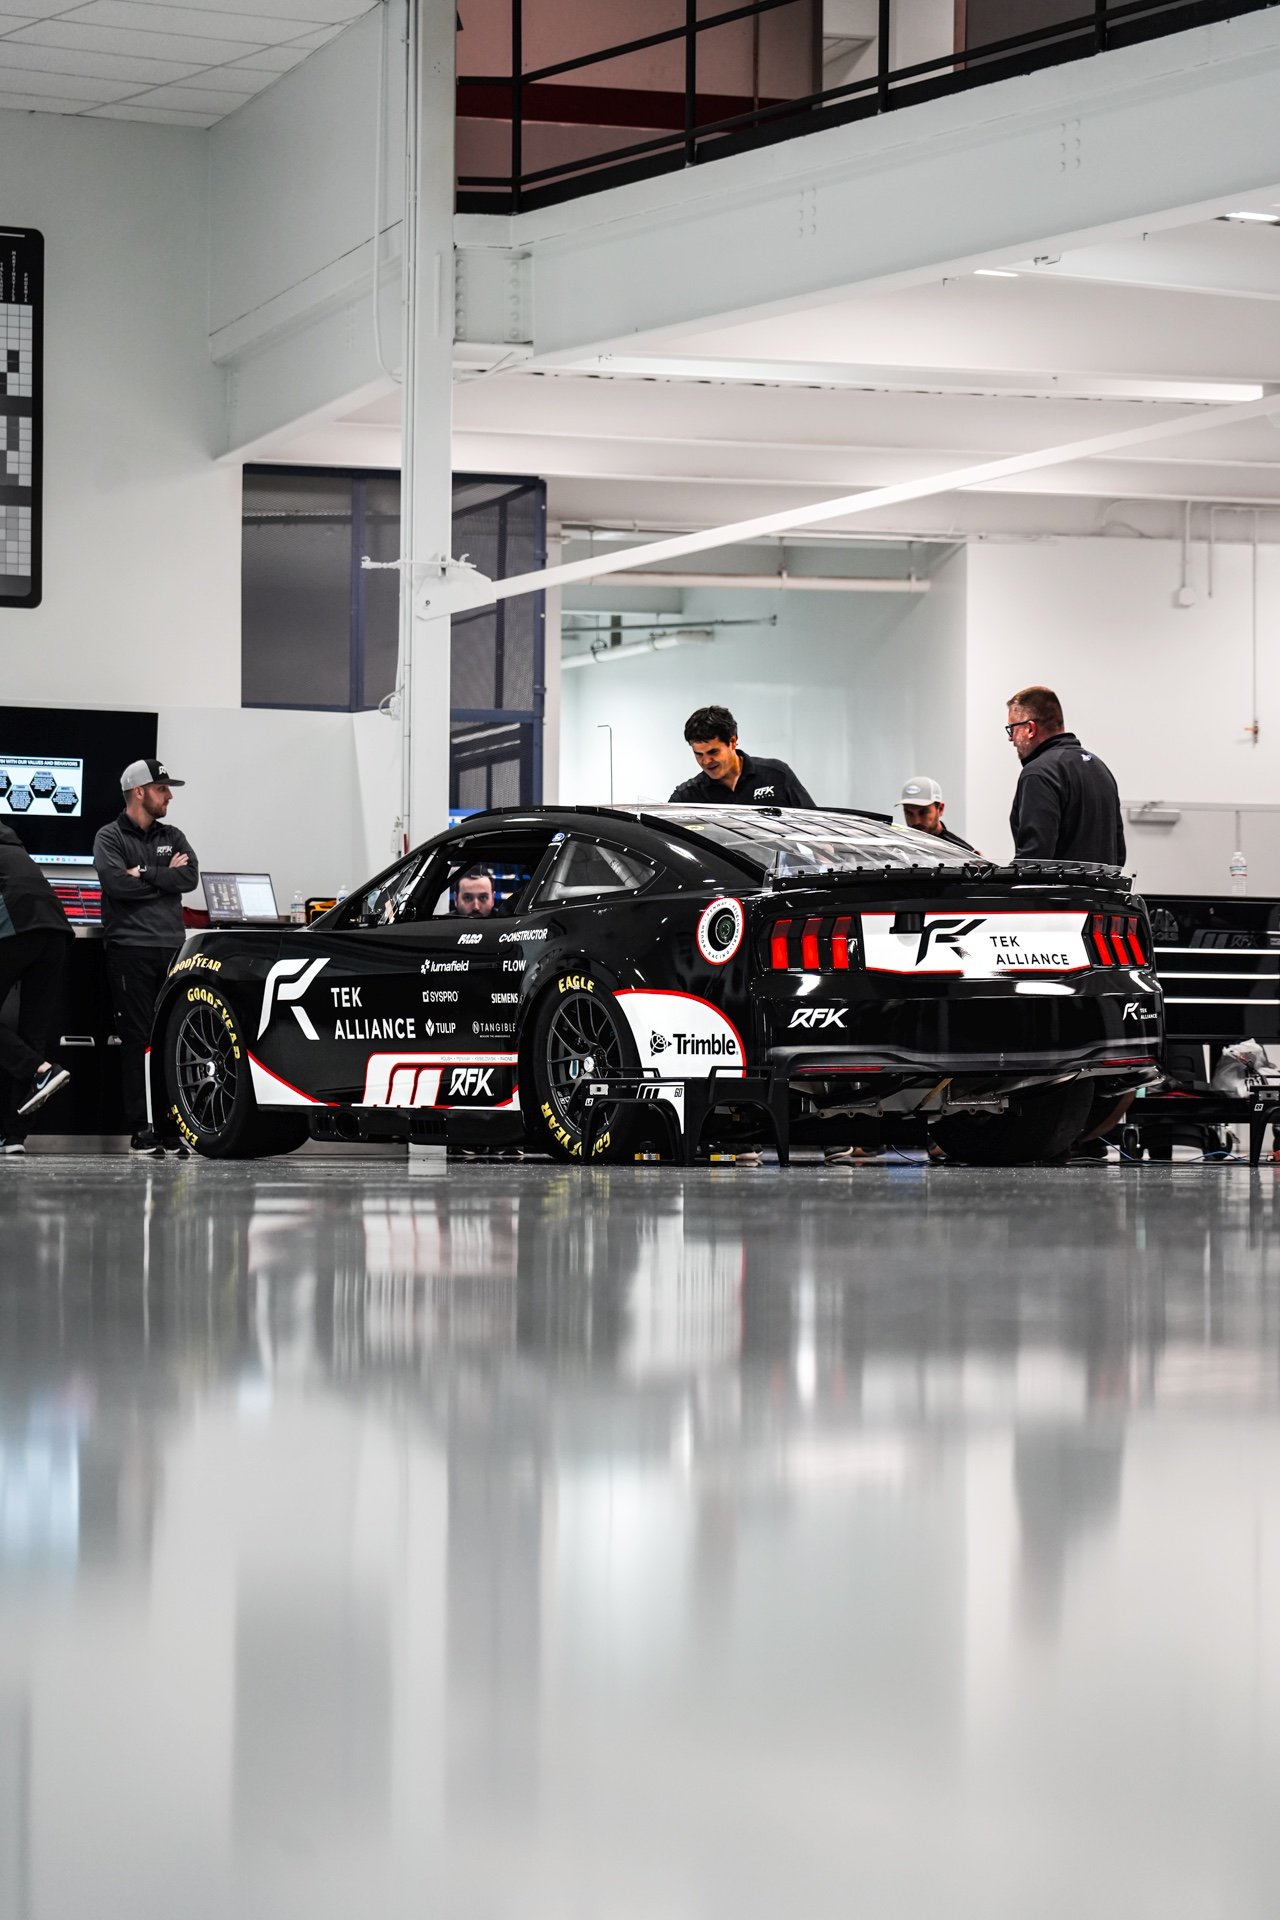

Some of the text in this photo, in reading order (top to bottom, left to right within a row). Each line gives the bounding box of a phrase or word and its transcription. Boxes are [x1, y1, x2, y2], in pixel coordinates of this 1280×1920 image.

[754, 786, 774, 797] RFK
[990, 936, 1020, 948] TEK
[169, 954, 222, 978] GOODYEAR
[431, 960, 469, 972] lumafield
[503, 960, 526, 972] FLOW
[996, 953, 1070, 965] ALLIANCE
[558, 975, 595, 993] EAGLE
[331, 987, 363, 1008] TEK
[430, 991, 458, 1002] SYSPRO
[491, 993, 518, 1004] SIEMENS
[187, 987, 240, 1060] GOODYEAR
[480, 1023, 516, 1032] TANGIBLE
[787, 1008, 849, 1029] RFK
[334, 1018, 417, 1040] ALLIANCE
[435, 1023, 456, 1034] TULIP
[673, 1033, 736, 1056] Trimble
[448, 1068, 495, 1097] RFK
[171, 1104, 199, 1147] EAGLE
[541, 1101, 611, 1156] GOYEAR
